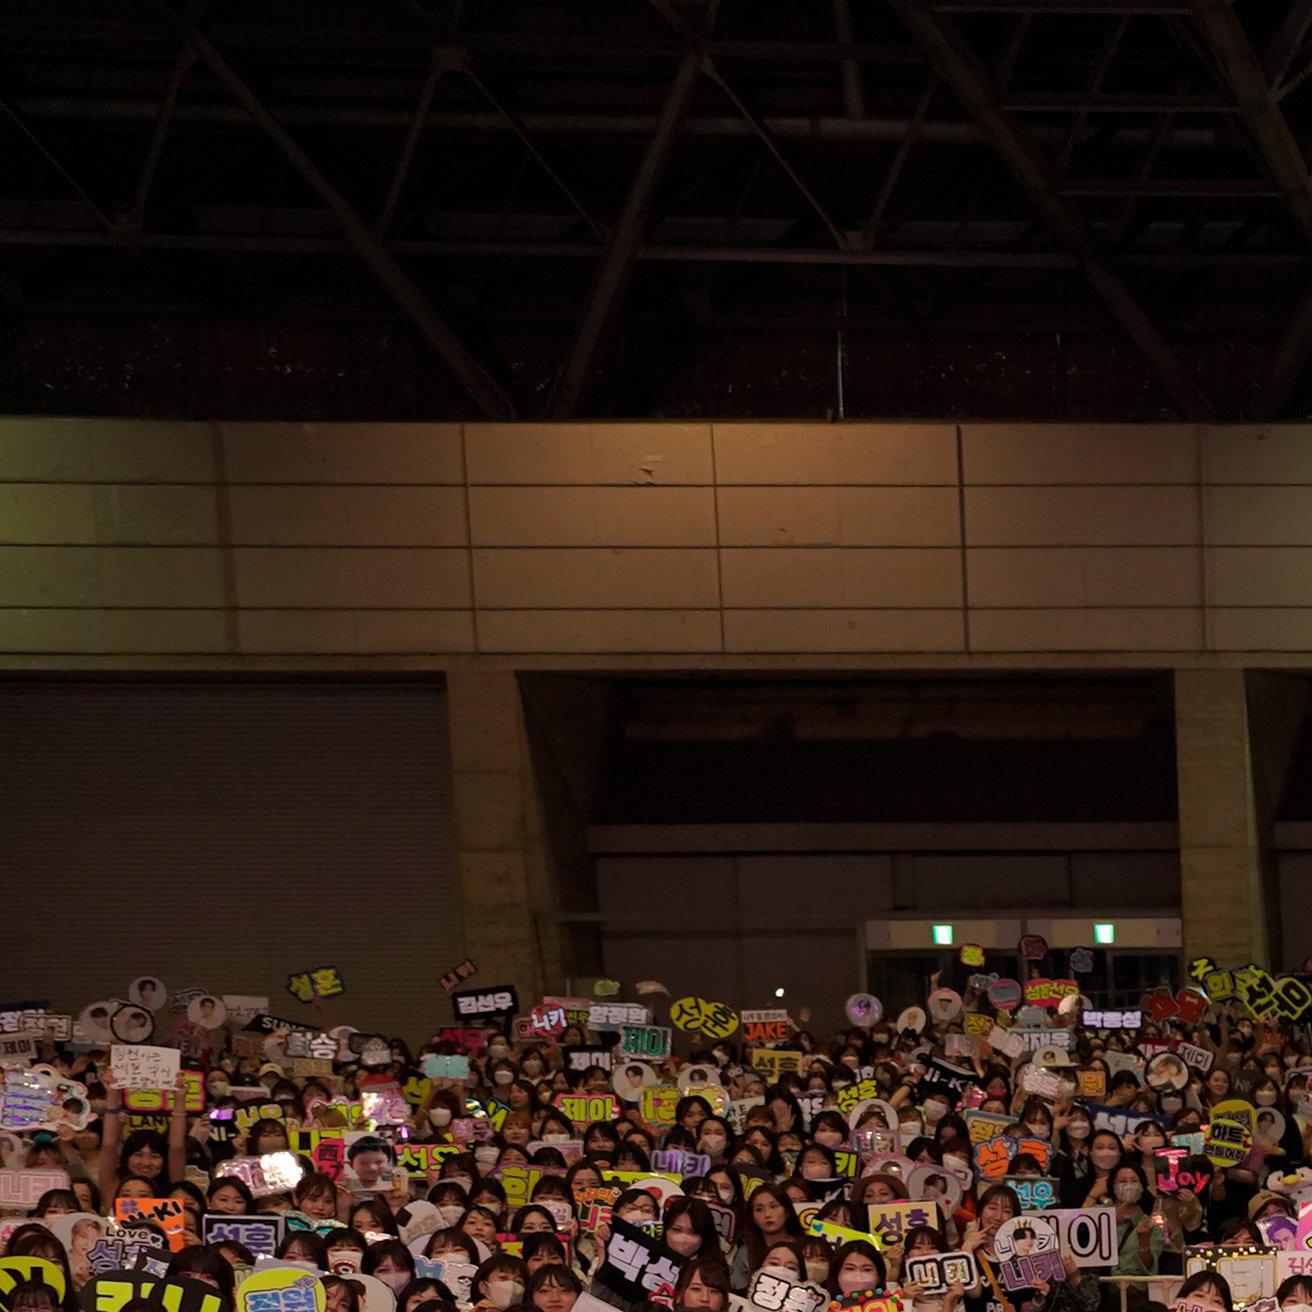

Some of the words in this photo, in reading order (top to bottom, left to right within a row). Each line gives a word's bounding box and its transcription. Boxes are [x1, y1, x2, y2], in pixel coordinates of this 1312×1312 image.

[457, 991, 514, 1014] 김선우
[745, 1023, 788, 1040] JAKE
[561, 1096, 613, 1123] 제이
[656, 1151, 710, 1177] 니키
[1157, 1148, 1212, 1193] Jay
[105, 1221, 149, 1238] Love
[609, 1233, 681, 1289] 박성
[912, 1259, 972, 1293] 니키
